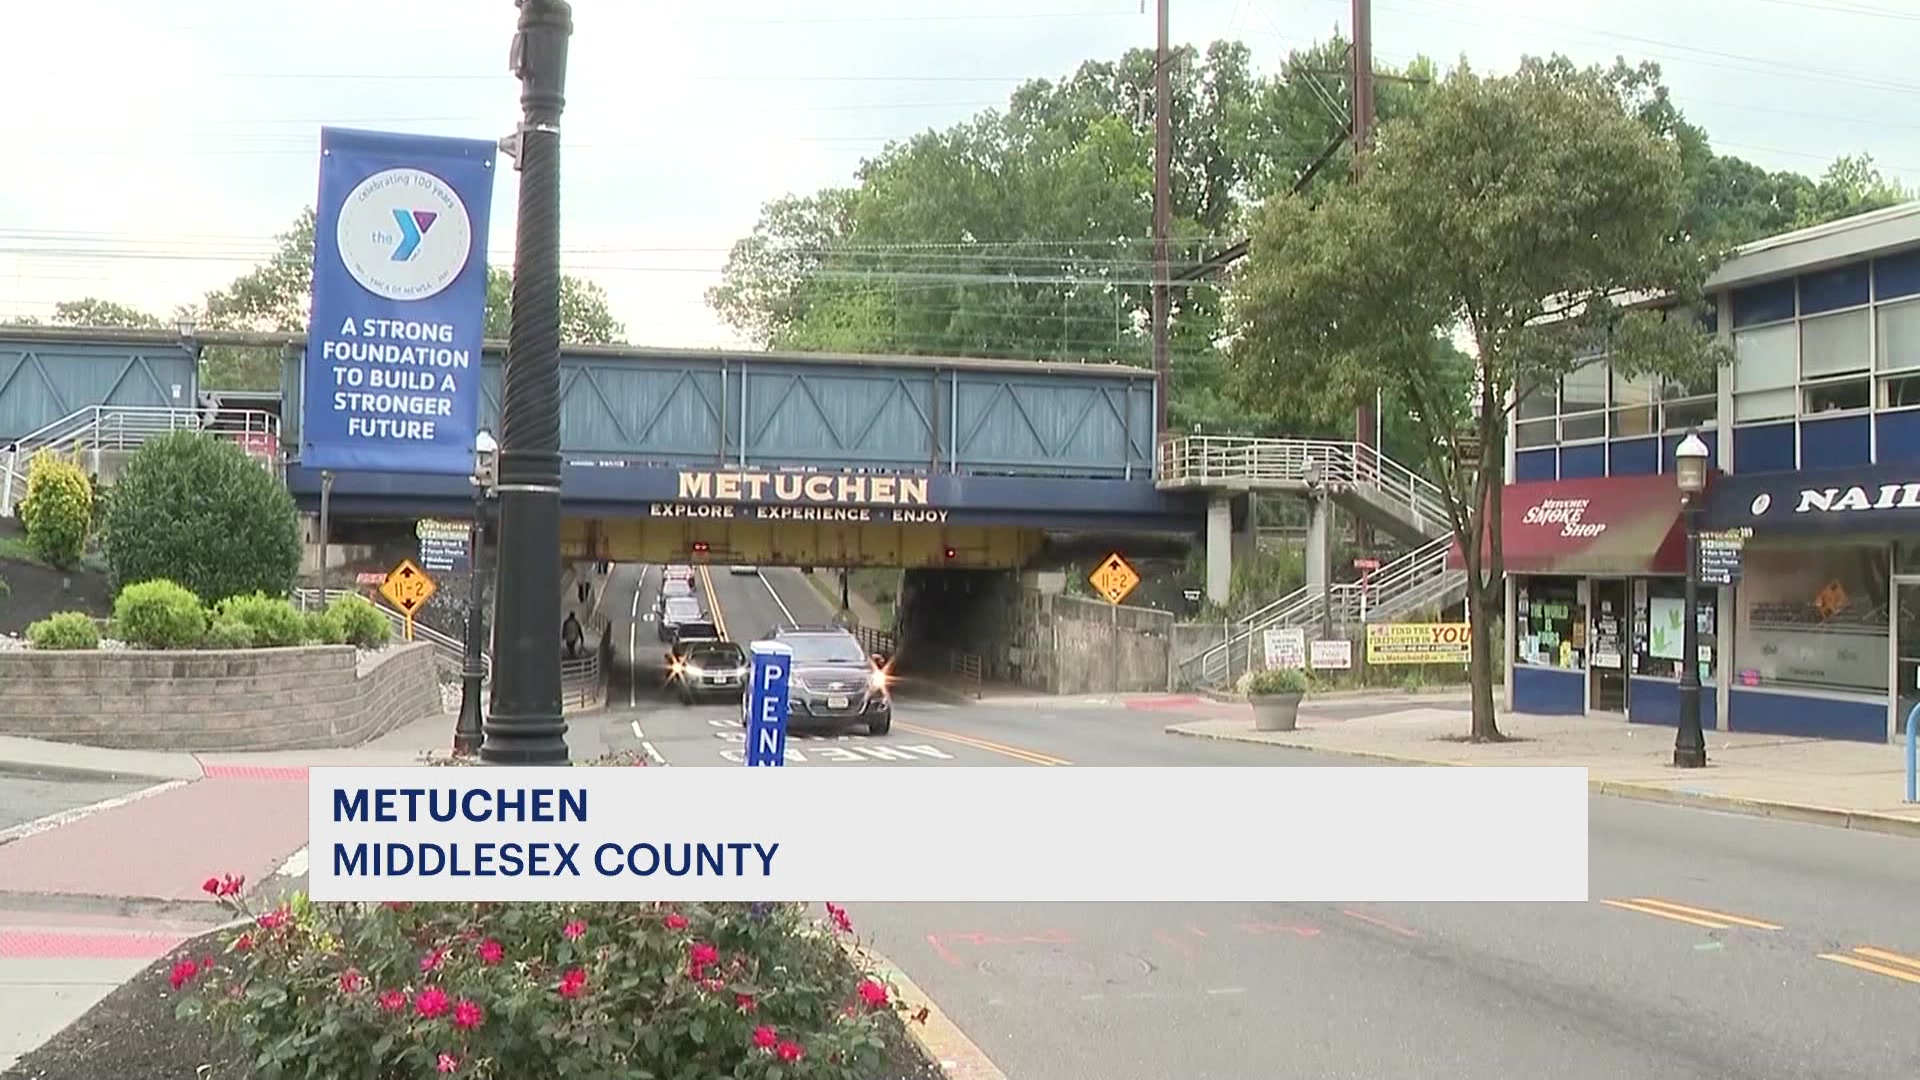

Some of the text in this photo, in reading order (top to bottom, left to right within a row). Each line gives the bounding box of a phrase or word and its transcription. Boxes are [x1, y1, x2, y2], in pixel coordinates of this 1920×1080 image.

[414, 175, 432, 189] 100
[433, 184, 455, 209] years
[372, 231, 393, 245] the
[341, 317, 453, 342] A STRONG
[323, 341, 469, 368] FOUNDATION
[333, 367, 456, 392] TO BUILD A
[334, 392, 451, 416] STRONGER
[348, 417, 435, 439] FUTURE
[678, 471, 929, 505] METUCHEN
[1795, 483, 1920, 513] NAIL
[650, 503, 949, 522] EXPLORE EXPERIENCE ENJOY
[1522, 506, 1585, 526] SMOKE
[1560, 521, 1606, 537] SHOP
[1432, 626, 1473, 644] YOU
[757, 664, 783, 767] PEN
